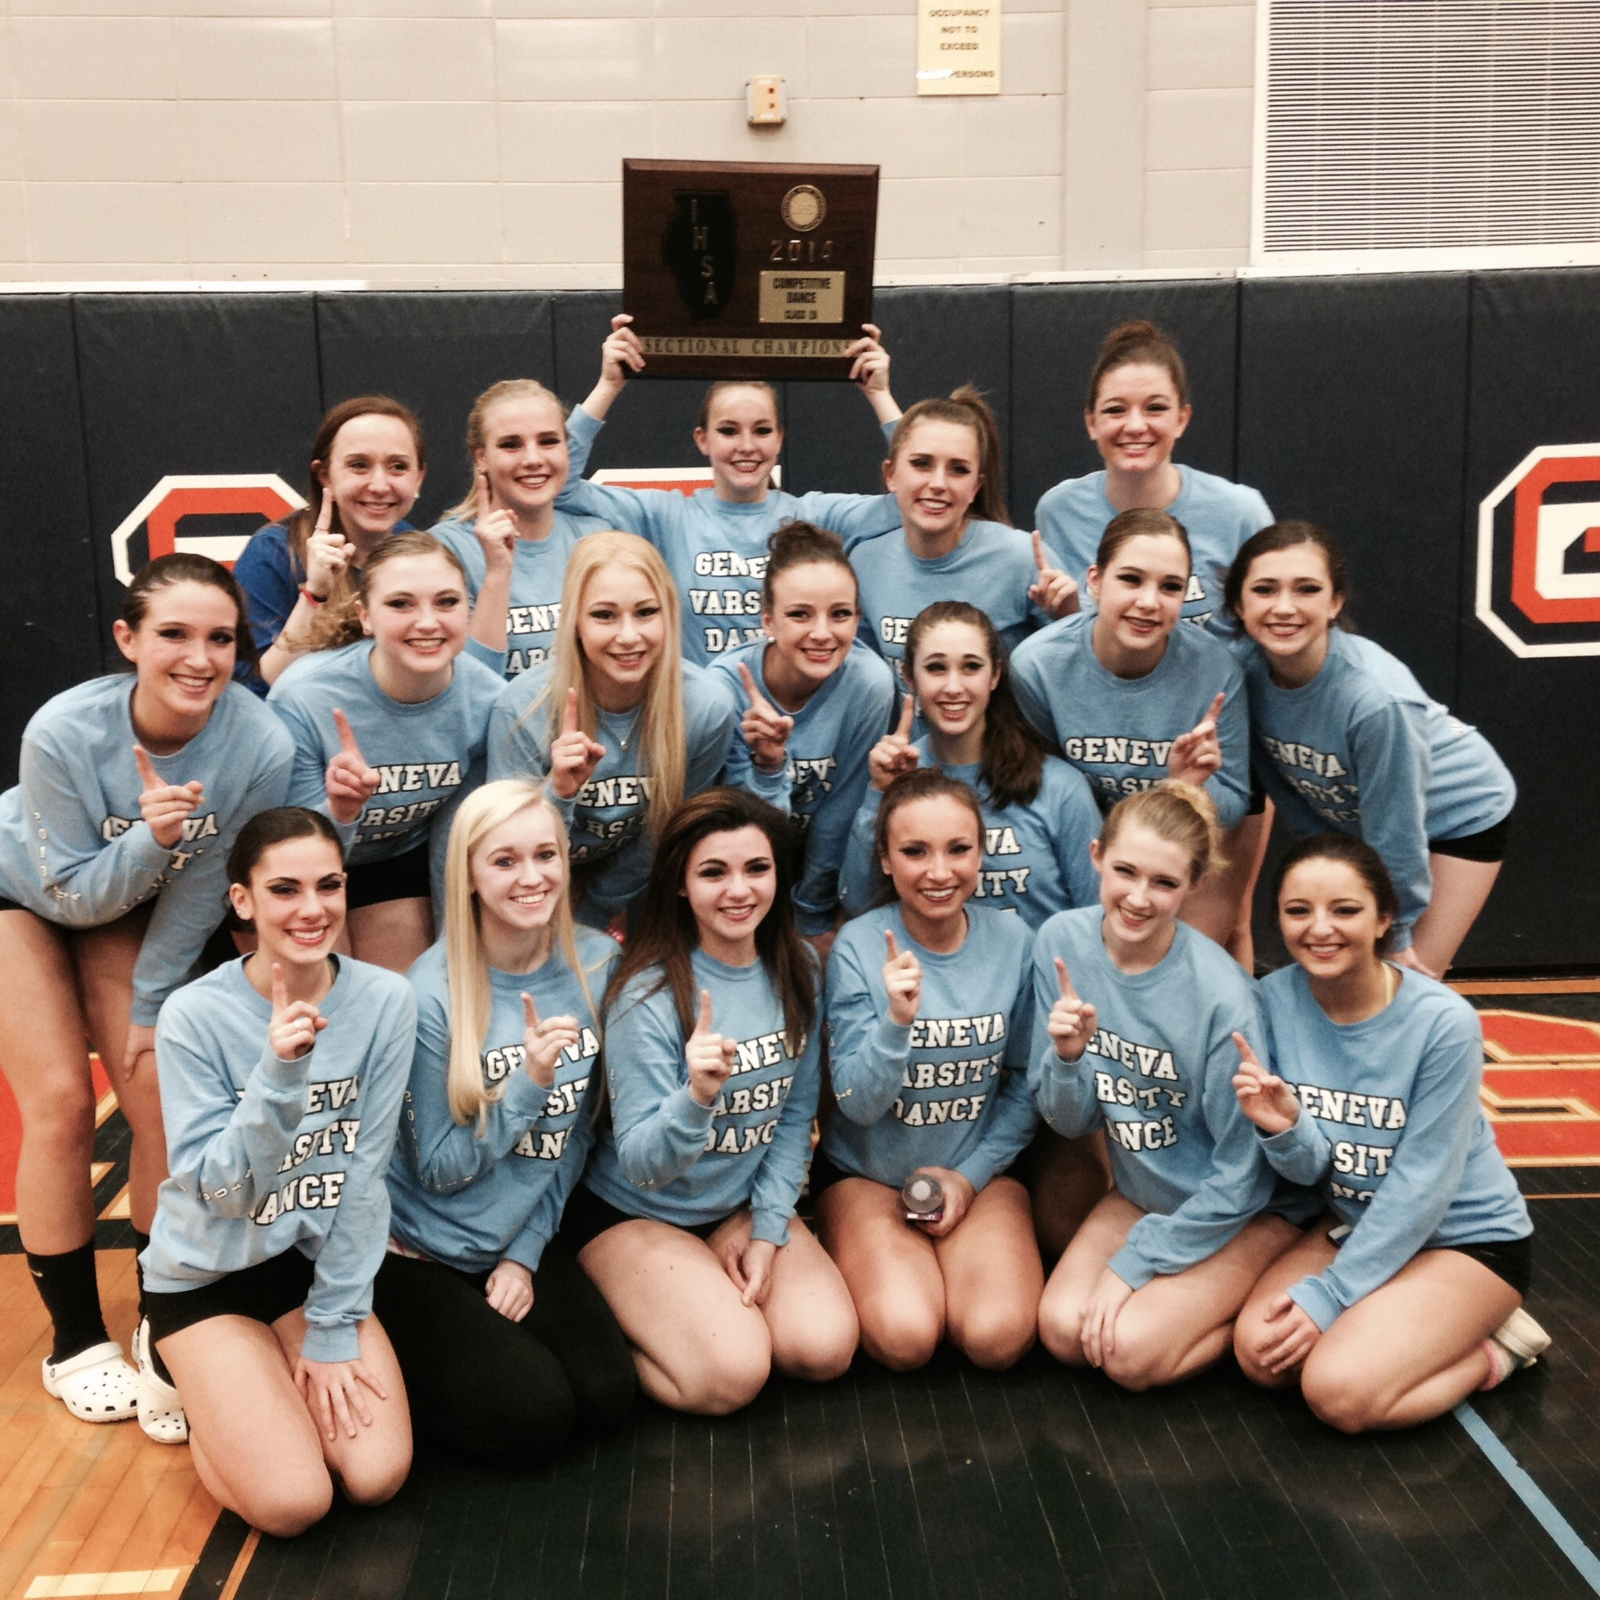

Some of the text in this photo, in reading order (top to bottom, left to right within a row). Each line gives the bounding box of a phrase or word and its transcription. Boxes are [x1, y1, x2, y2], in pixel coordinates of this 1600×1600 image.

[929, 9, 990, 17] OCCUPANCY
[940, 26, 978, 34] NOT TO
[940, 43, 979, 51] EXCEED
[953, 70, 995, 78] ERSONS
[644, 337, 740, 354] SECTIONAL
[694, 550, 771, 579] GENE
[689, 588, 763, 615] VARS
[704, 627, 768, 652] DAN
[1065, 736, 1172, 767] GENEV
[1262, 735, 1347, 779] ENEVA
[370, 761, 462, 796] NEVA
[361, 798, 449, 827] RSIT
[908, 1012, 1006, 1049] ENEVA
[901, 1051, 1003, 1090] RSITY
[1085, 1027, 1180, 1081] ENEVA
[304, 1075, 361, 1116] EVA
[703, 1075, 794, 1118] RSIT
[1286, 1081, 1407, 1131] ENEVA
[702, 1118, 778, 1155] ANC
[1105, 1114, 1179, 1152] NCE
[252, 1170, 347, 1227] ANCE
